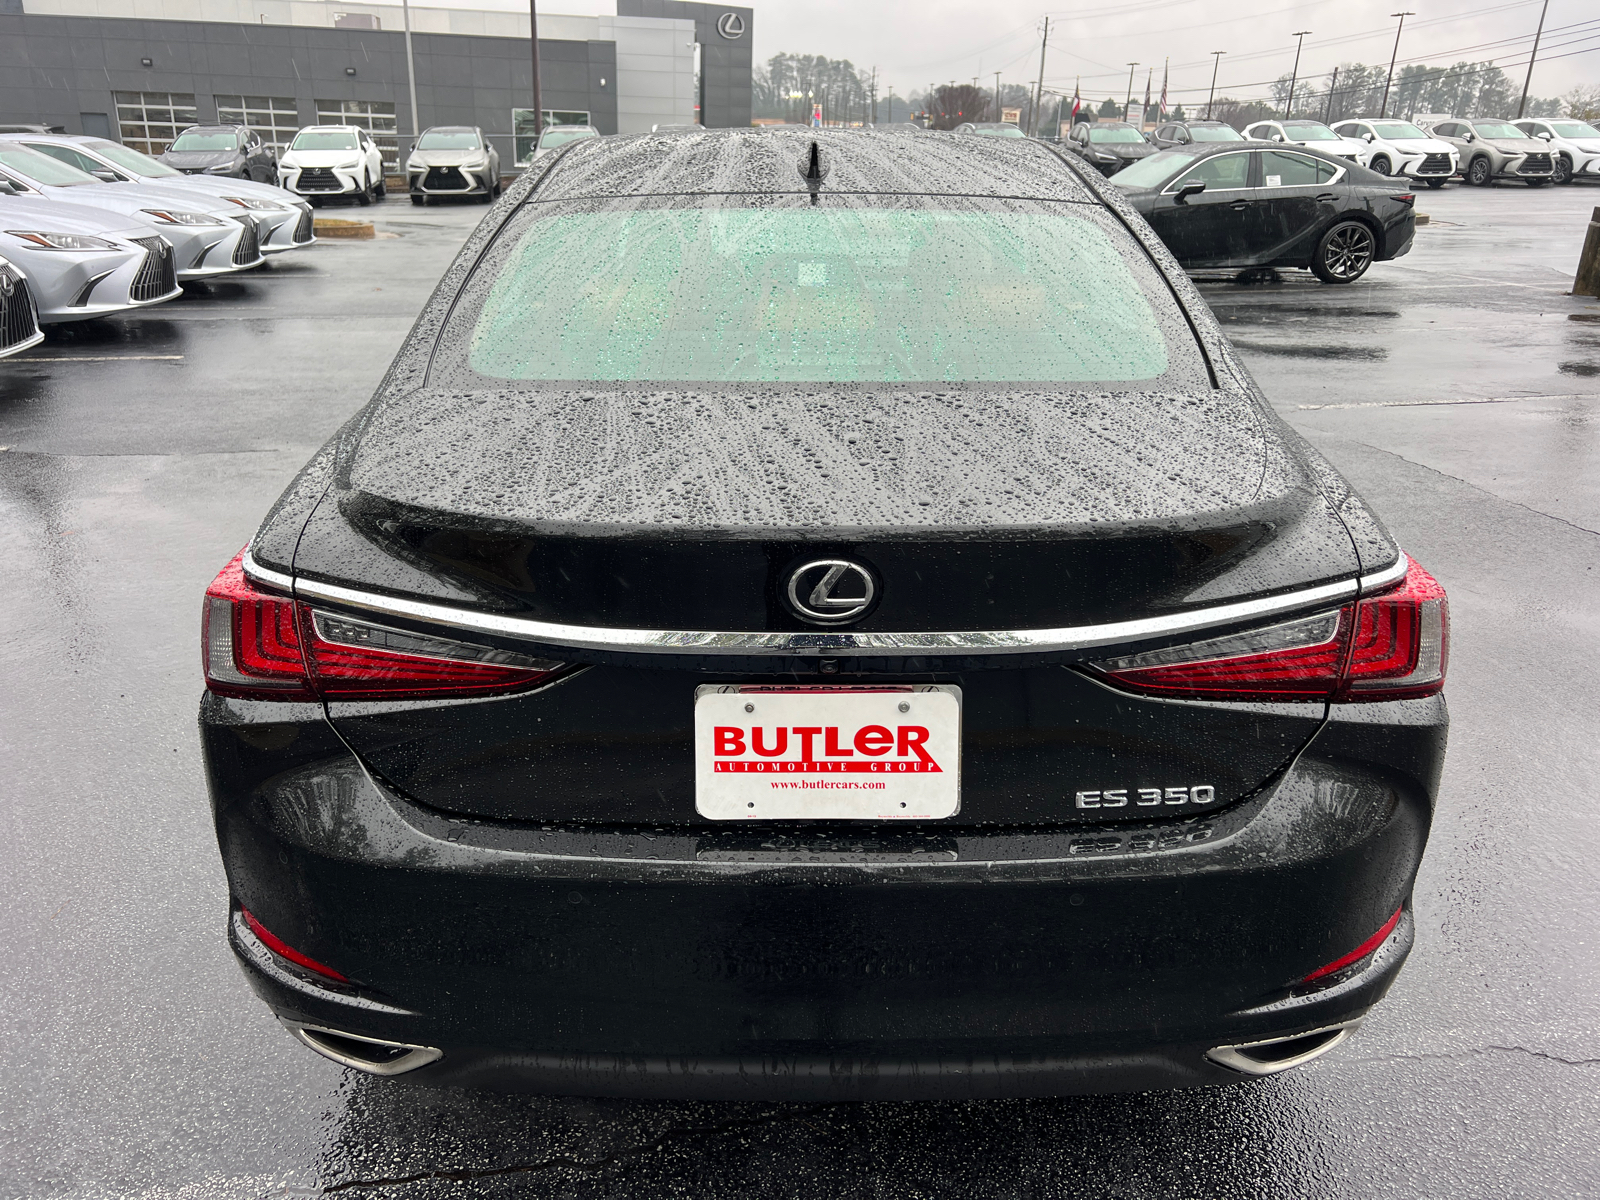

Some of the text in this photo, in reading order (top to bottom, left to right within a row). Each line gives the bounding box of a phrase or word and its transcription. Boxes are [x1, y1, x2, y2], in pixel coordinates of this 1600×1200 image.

[715, 762, 935, 772] AUTOMOTIVE GROUP
[770, 779, 886, 790] www.butlercars.com
[1075, 785, 1216, 809] ES 350
